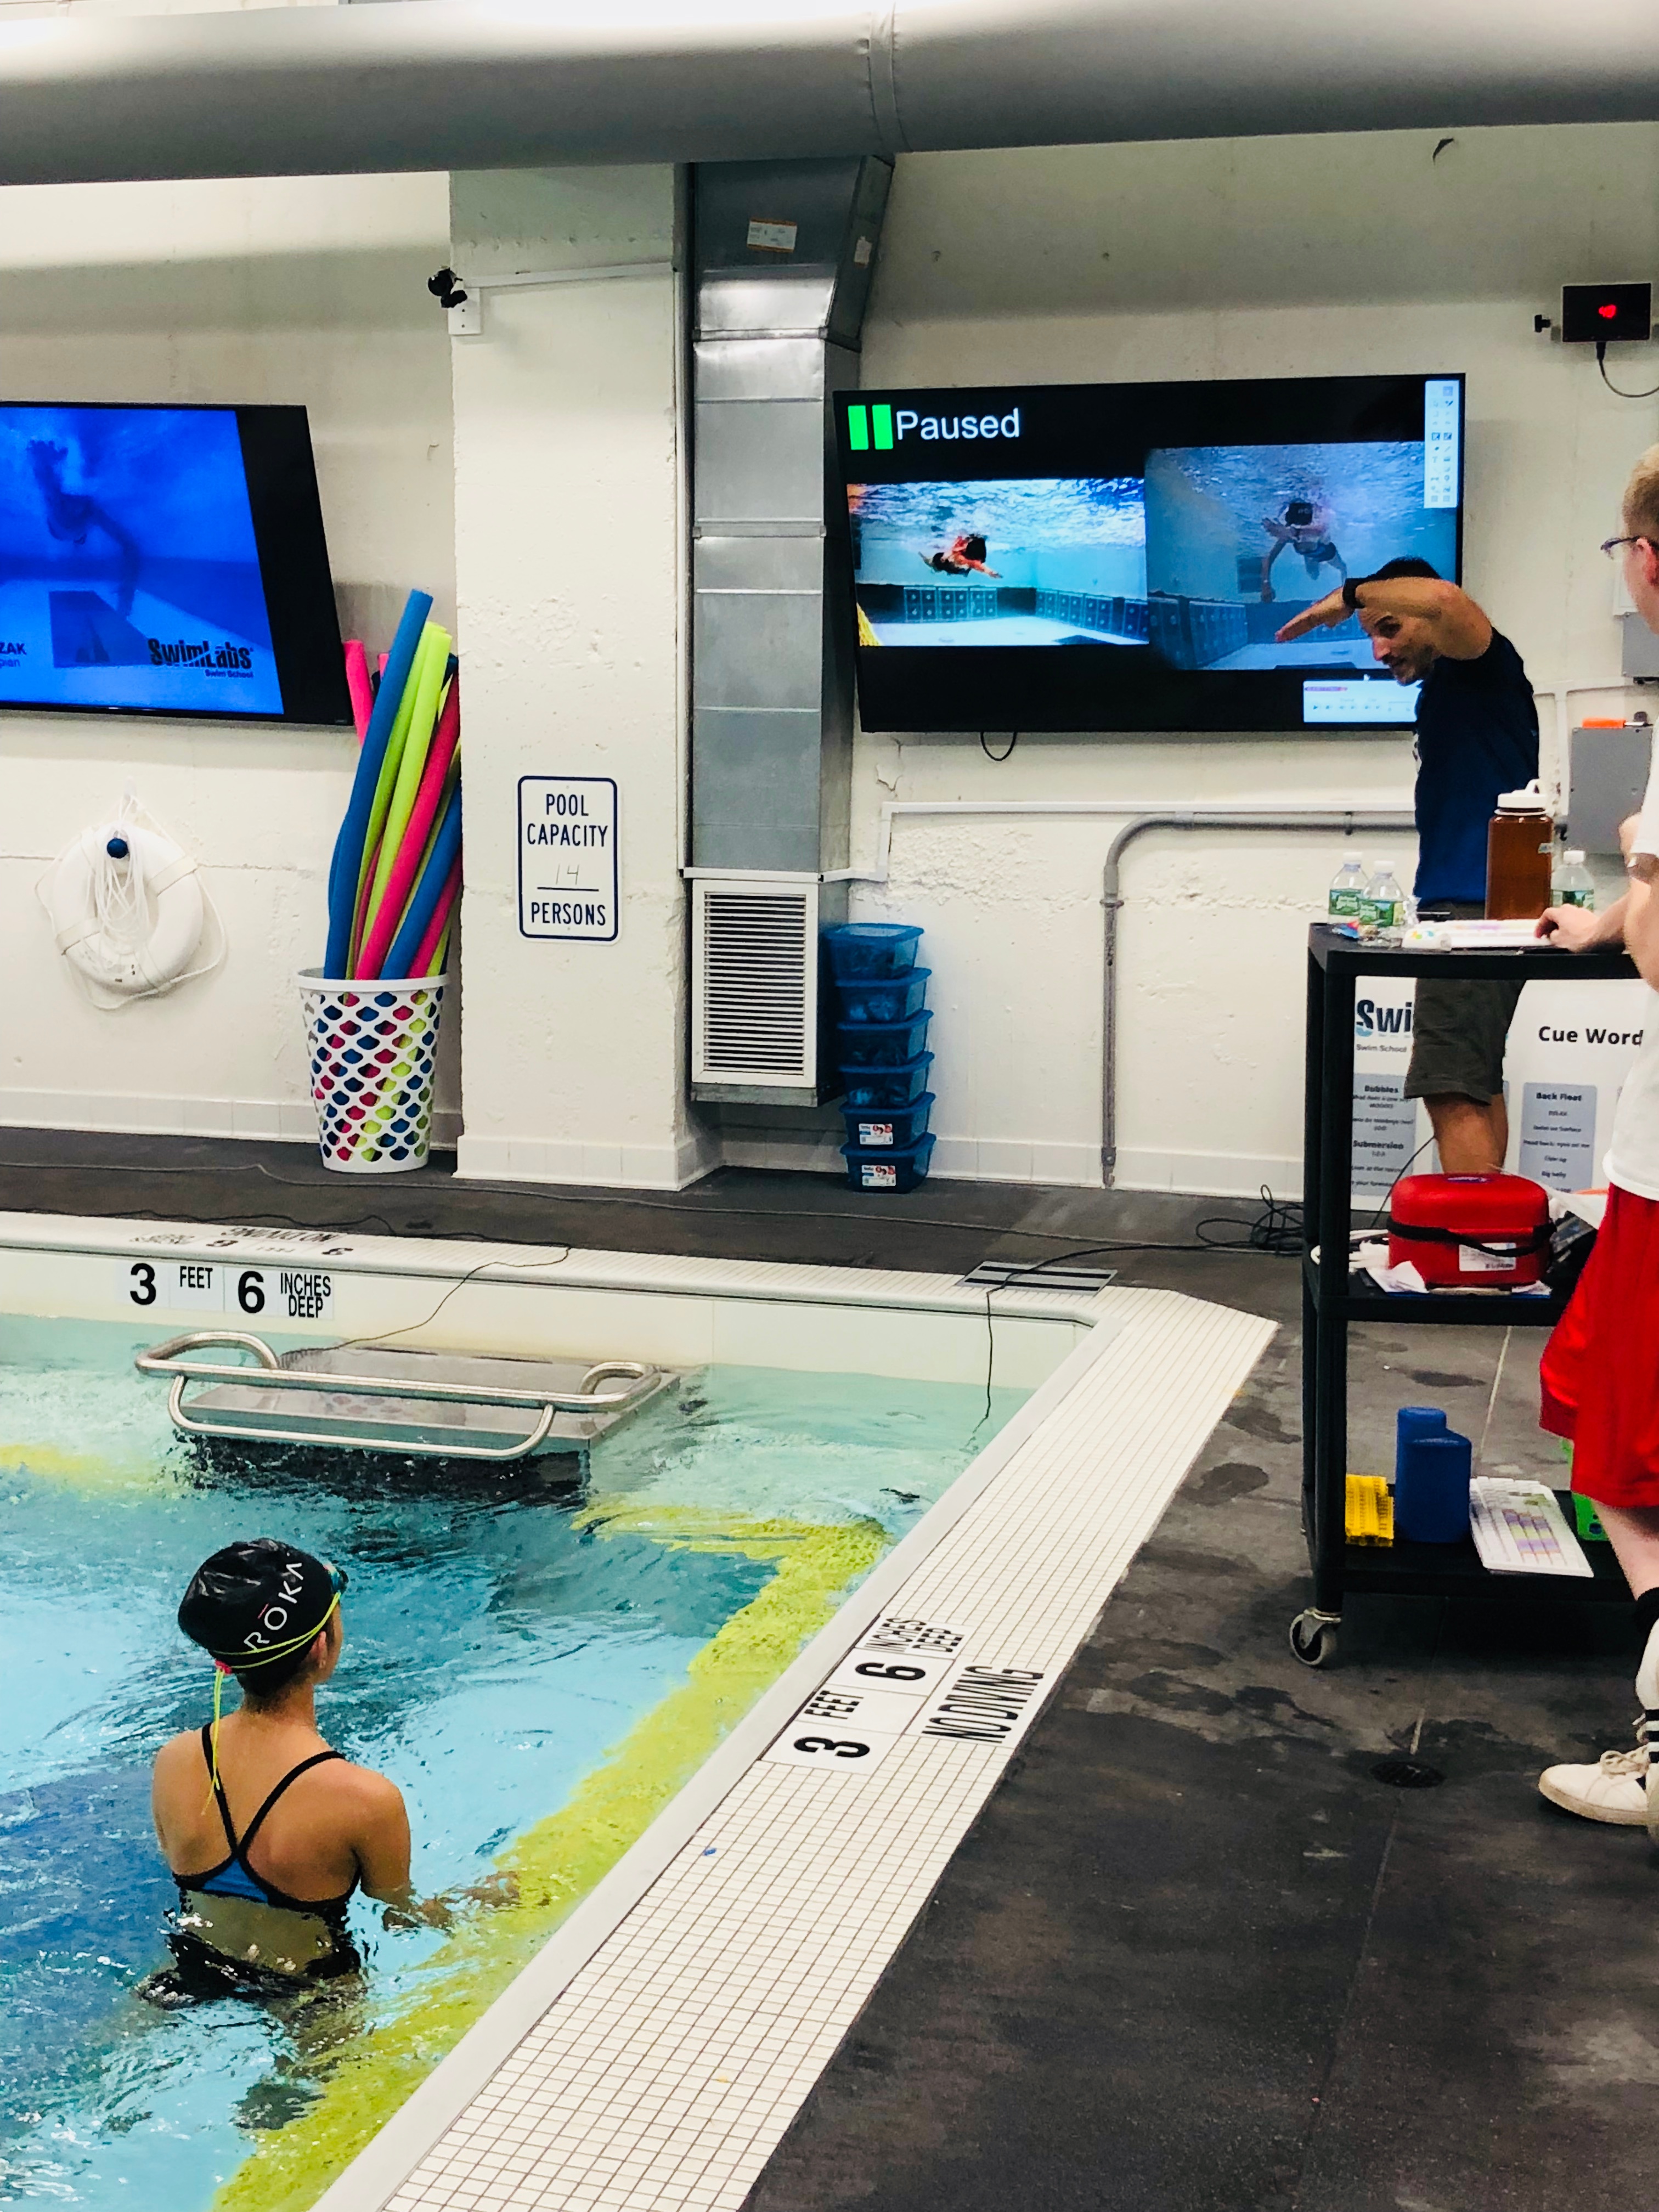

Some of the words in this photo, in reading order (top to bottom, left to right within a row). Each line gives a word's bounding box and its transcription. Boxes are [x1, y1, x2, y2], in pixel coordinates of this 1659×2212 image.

[896, 408, 1019, 440] Paused
[546, 793, 589, 816] POOL
[527, 823, 608, 847] CAPACITY
[531, 901, 606, 926] PERSONS
[1538, 1026, 1578, 1043] Cue
[1536, 1092, 1558, 1101] Back
[1560, 1093, 1582, 1101] Float
[129, 1262, 156, 1306] 3
[179, 1266, 213, 1289] FEET
[238, 1271, 265, 1313] 6
[280, 1272, 331, 1297] INCHES
[288, 1295, 323, 1318] DEEP
[864, 1617, 927, 1652] INCHES
[911, 1627, 965, 1653] DEEP
[855, 1662, 926, 1680] 6
[804, 1690, 864, 1719] FEET
[938, 1666, 1045, 1720] DIVING
[922, 1717, 1012, 1743] NO
[793, 1737, 870, 1758] 3
